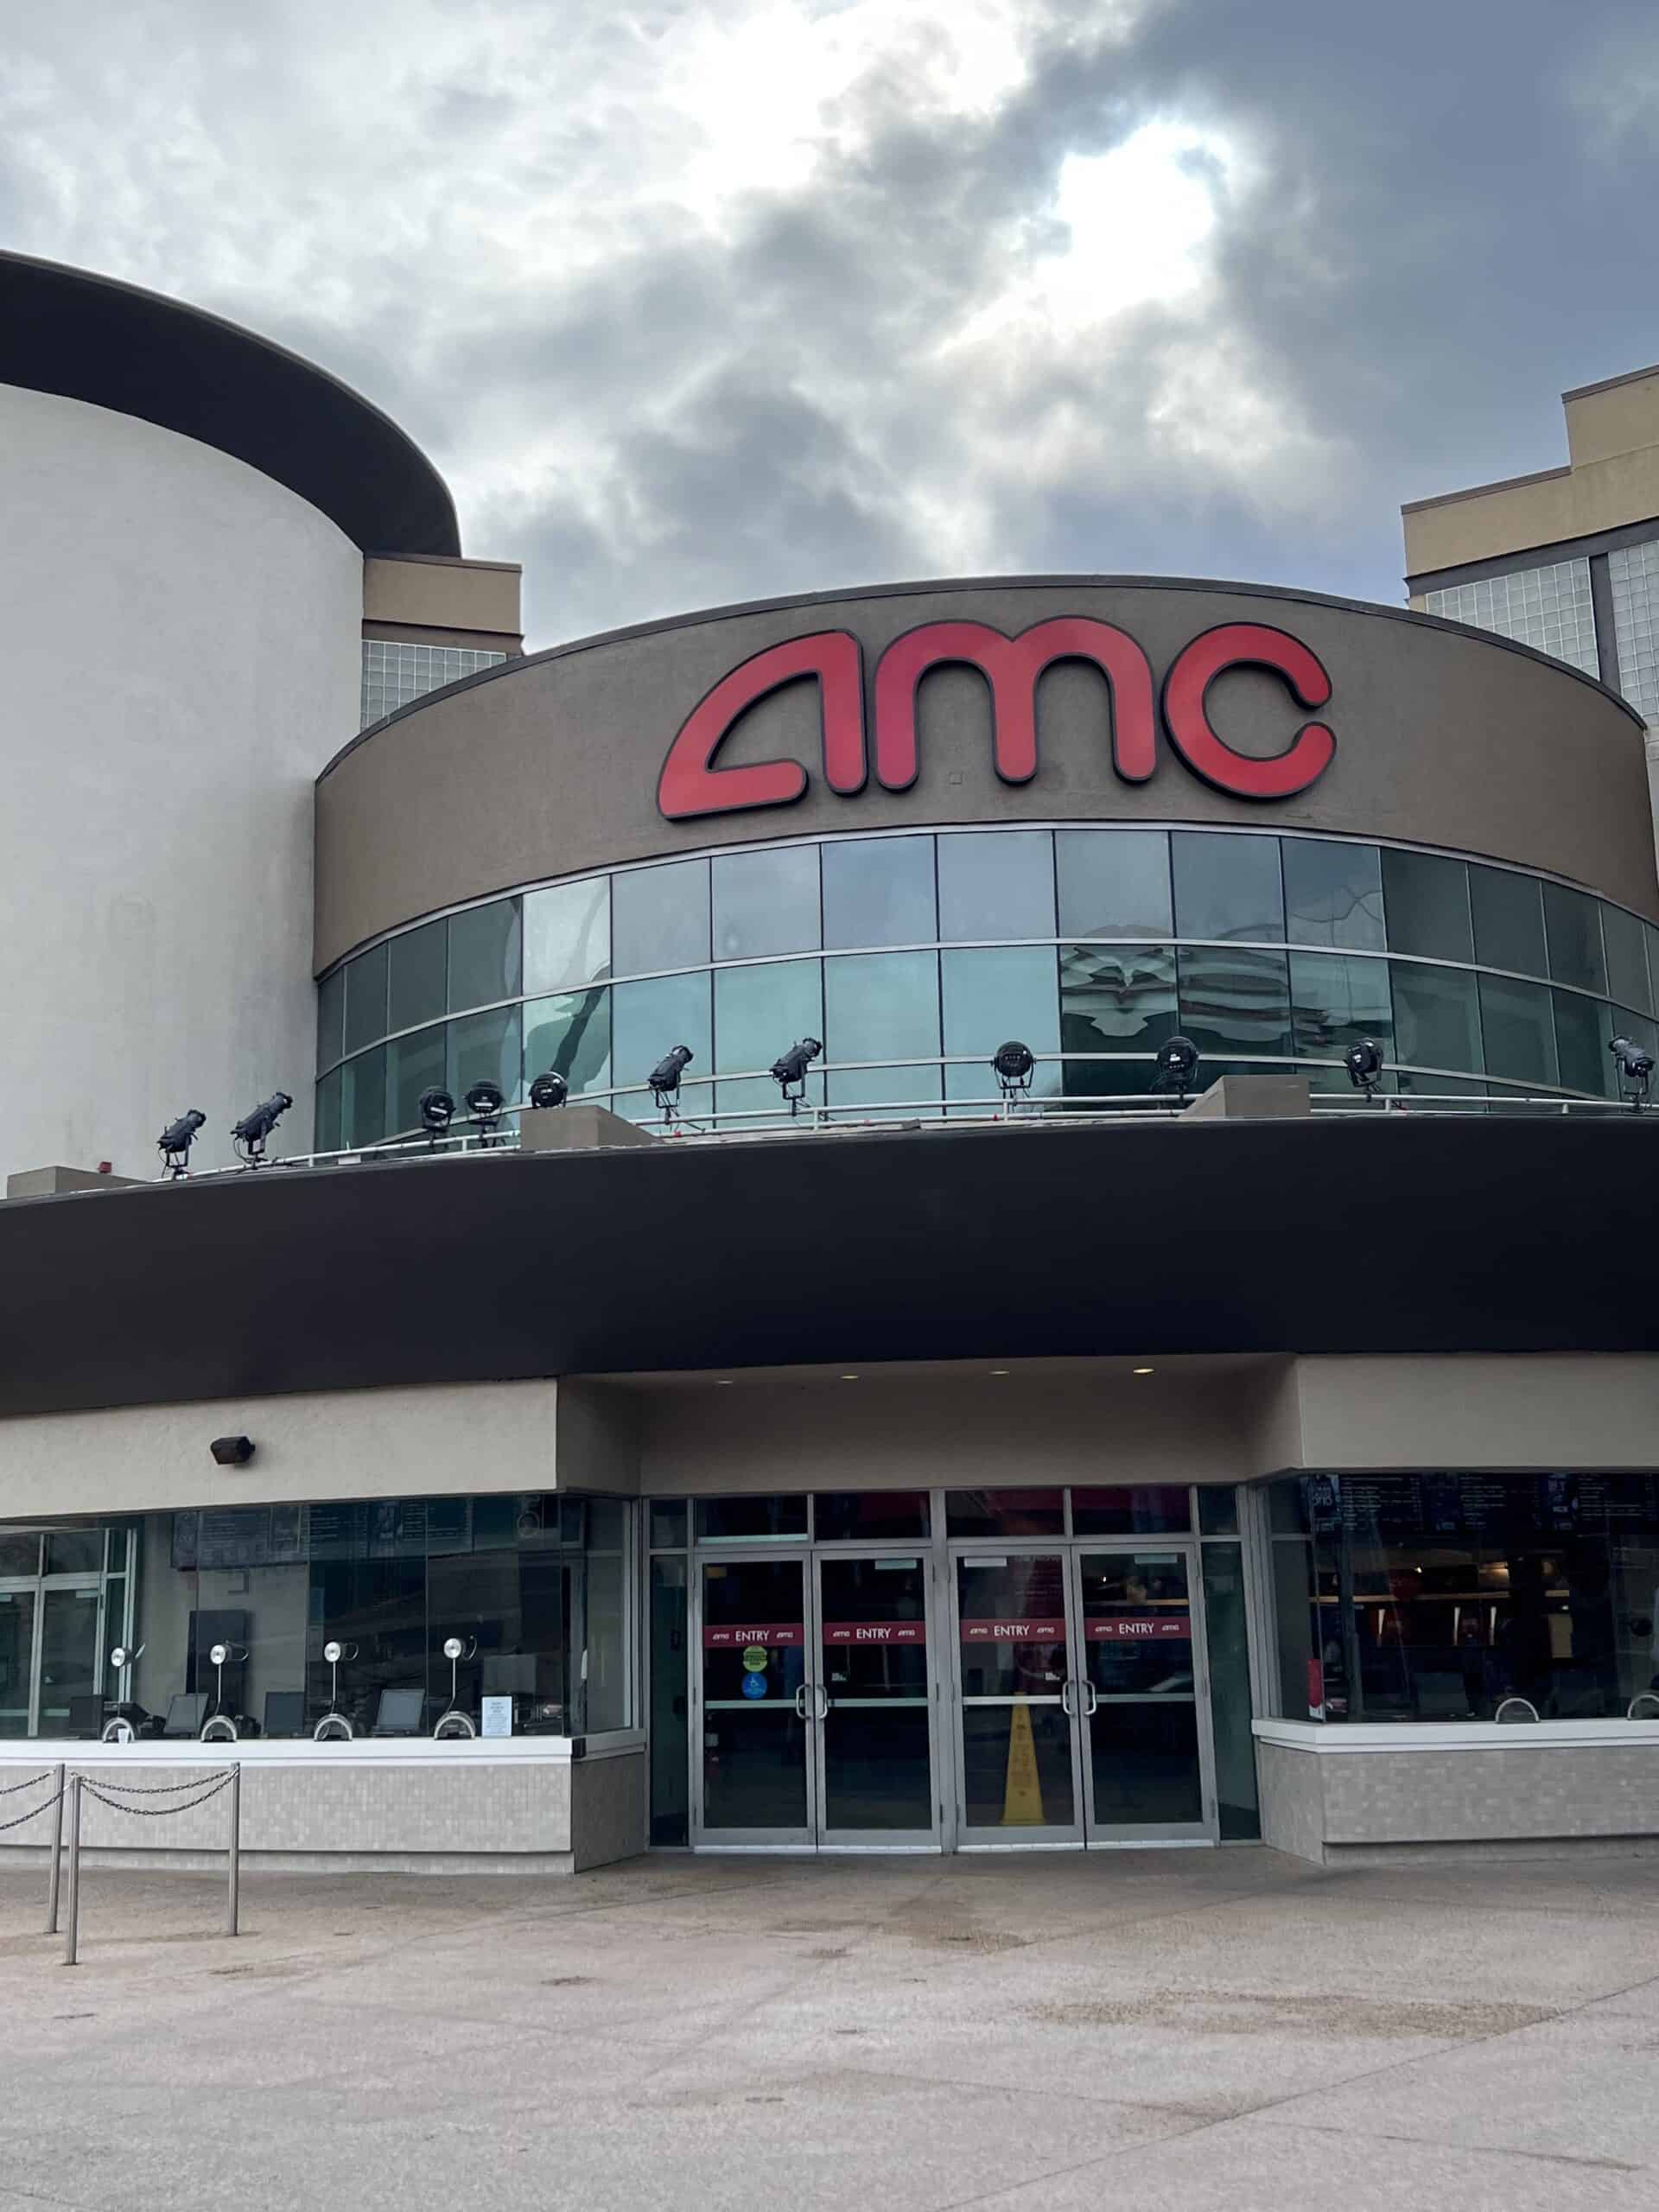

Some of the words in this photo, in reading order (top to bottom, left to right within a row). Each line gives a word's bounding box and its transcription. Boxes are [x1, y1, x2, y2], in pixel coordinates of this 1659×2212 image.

[657, 615, 1336, 822] amc
[856, 1628, 891, 1639] ENTRY
[994, 1624, 1030, 1637] ENTRY
[1118, 1623, 1154, 1635] ENTRY
[735, 1630, 770, 1642] ENTRY
